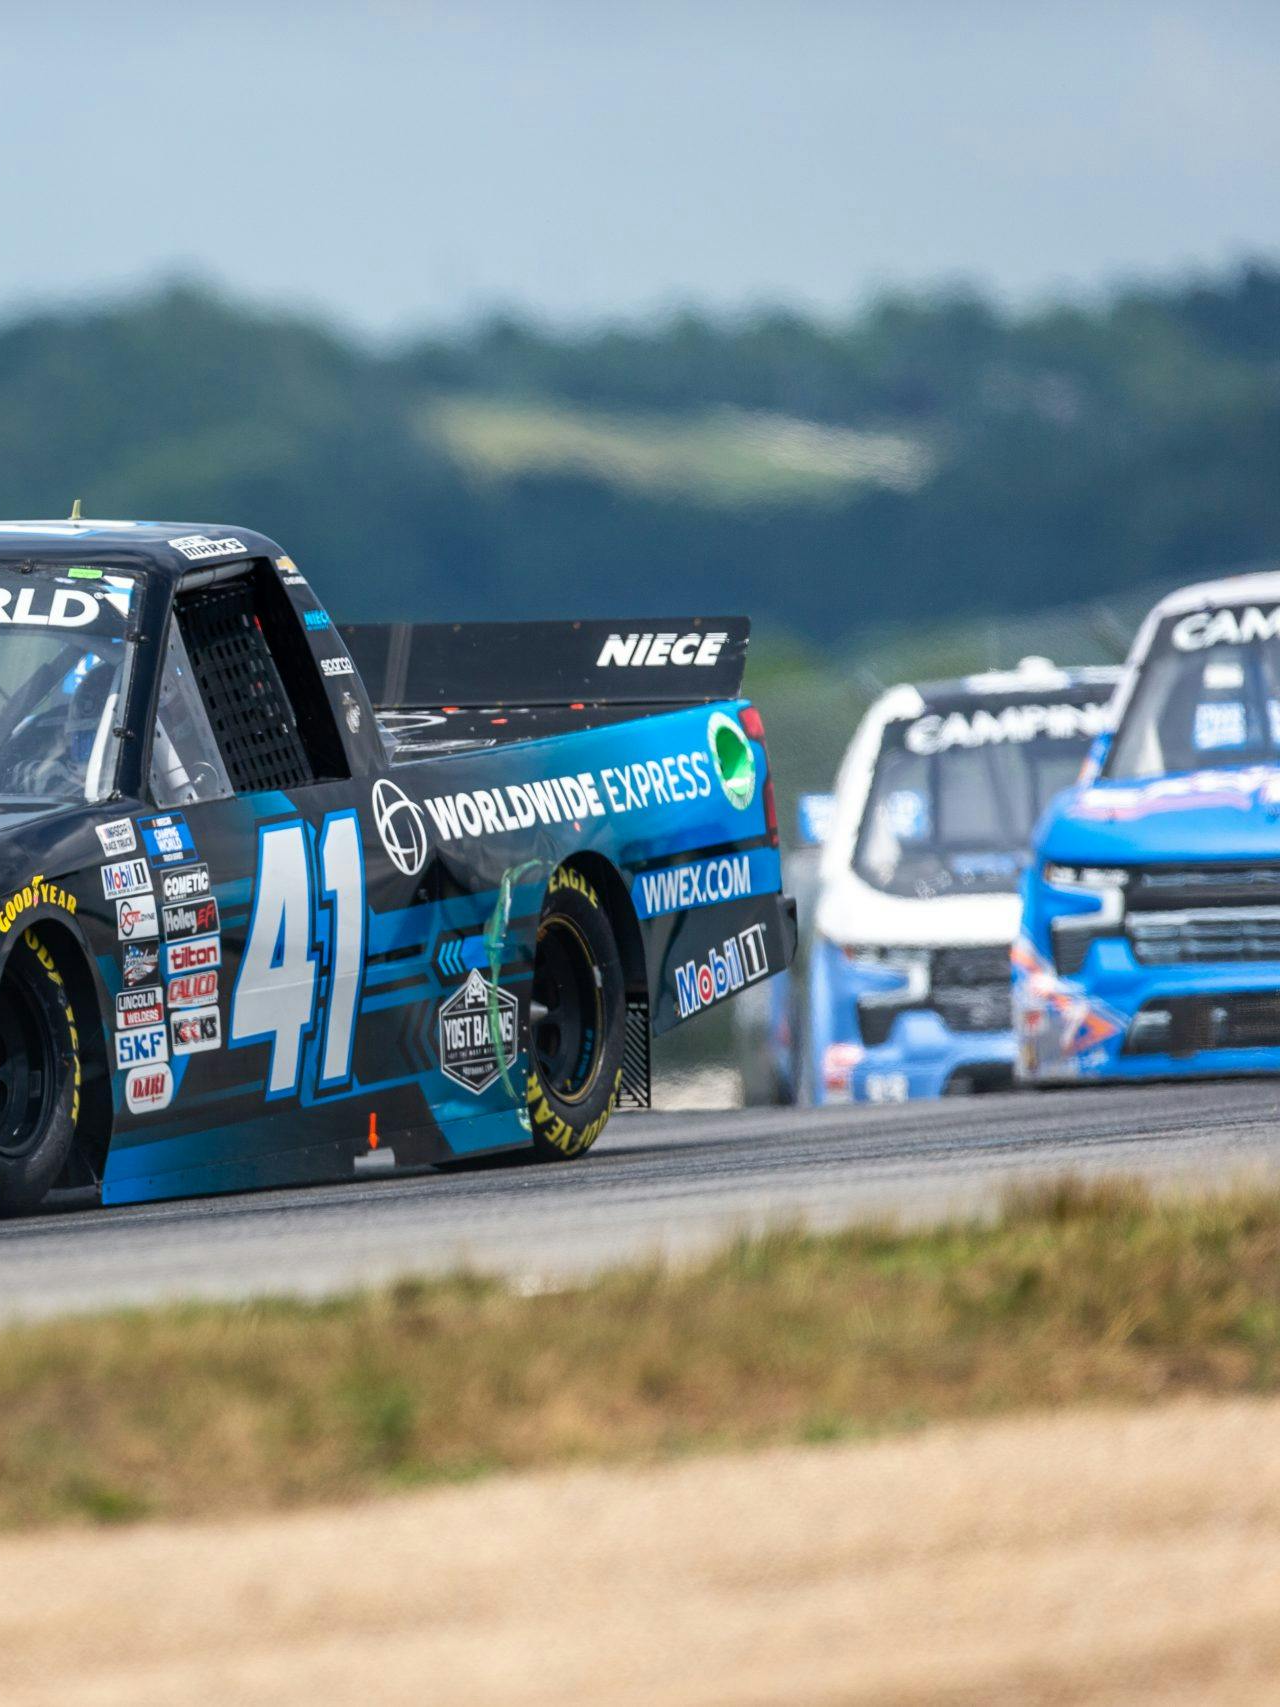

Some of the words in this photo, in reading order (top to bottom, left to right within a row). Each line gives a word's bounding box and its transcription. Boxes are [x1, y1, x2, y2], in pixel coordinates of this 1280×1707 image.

[182, 540, 243, 557] MARKS
[596, 632, 728, 667] NIECE
[424, 772, 606, 841] WORLDWIDE
[600, 753, 711, 812] EXPRESS
[104, 864, 135, 891] Mobil
[164, 871, 209, 896] COMETIC
[641, 855, 752, 914] WWEX.COM
[165, 907, 197, 934] Holley
[170, 945, 218, 970] tilton
[230, 811, 365, 1098] 41
[168, 973, 216, 1001] CALICO
[675, 936, 745, 1018] Mobil
[119, 991, 155, 1010] LINCOLN
[444, 1015, 472, 1051] YOST
[473, 1011, 513, 1047] BANS
[120, 1031, 164, 1062] SKF
